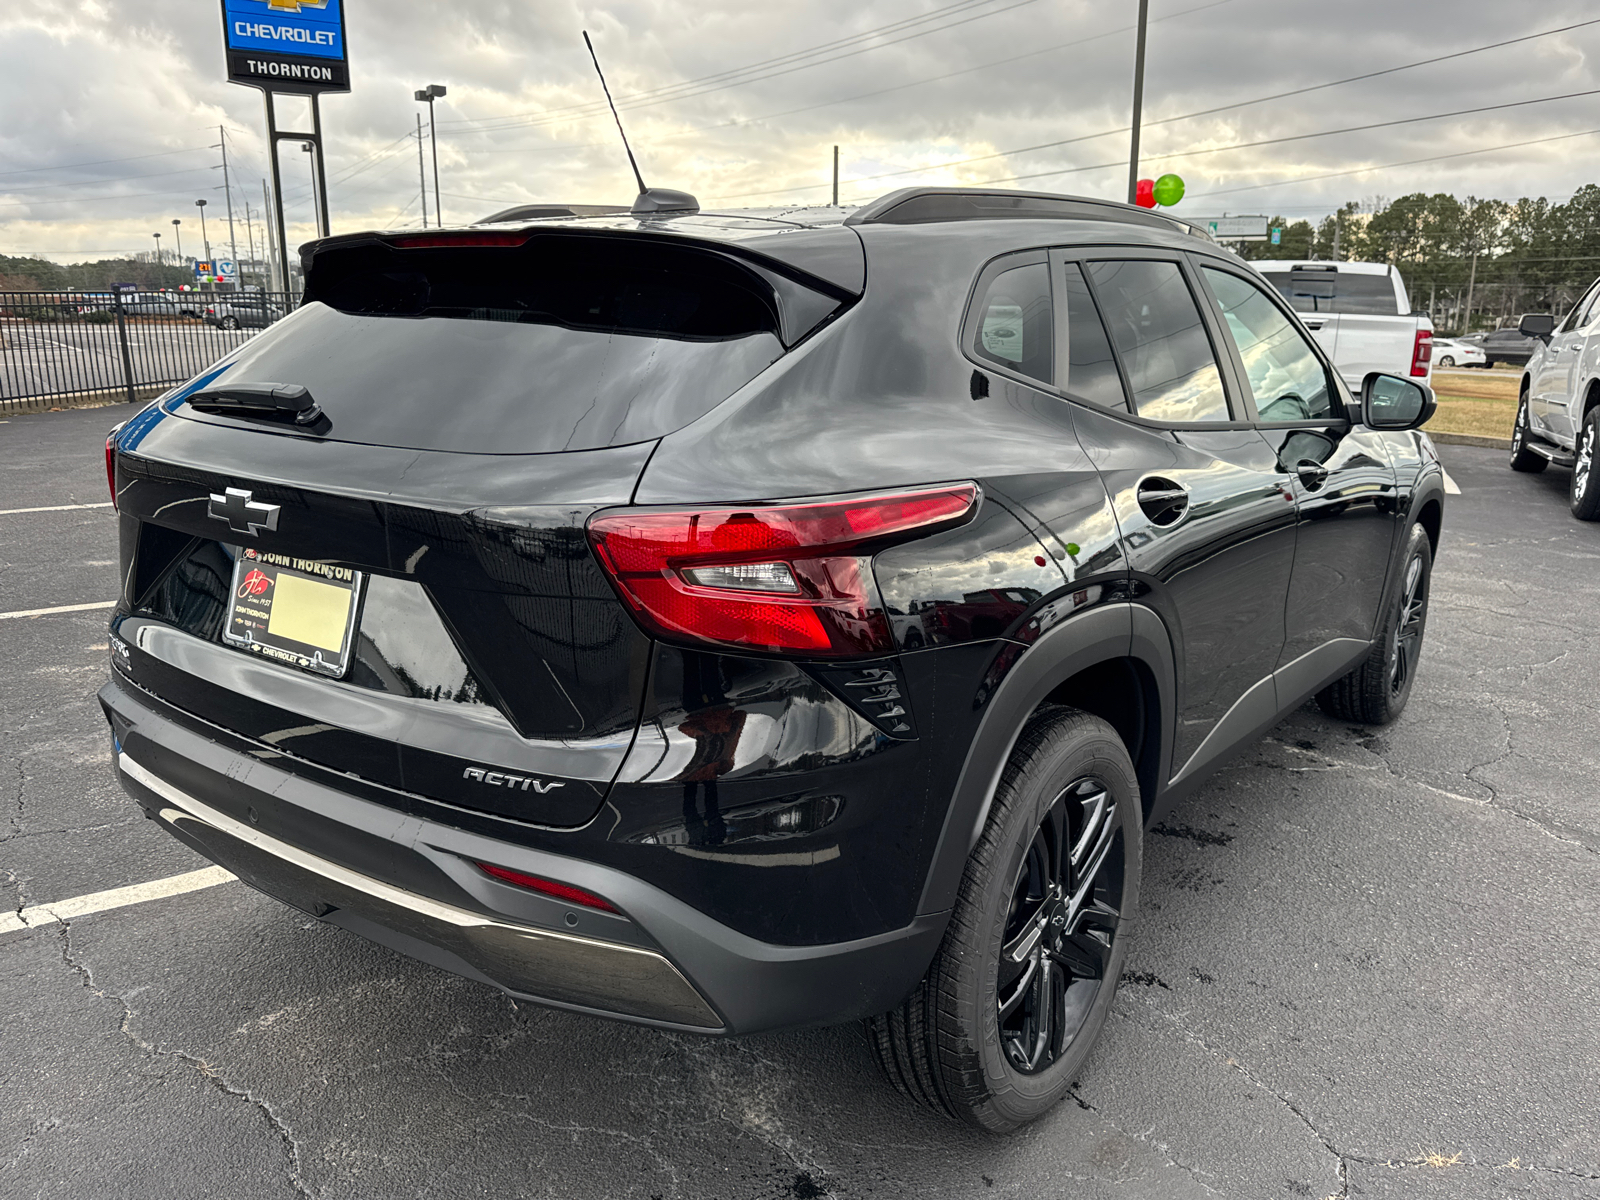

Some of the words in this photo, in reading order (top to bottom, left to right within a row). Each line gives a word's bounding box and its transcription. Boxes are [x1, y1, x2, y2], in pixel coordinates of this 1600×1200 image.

[235, 22, 336, 46] CHEVROLET
[247, 60, 332, 80] THORNTON
[262, 552, 290, 567] JOHN
[262, 647, 298, 663] CHEVROLET
[462, 766, 566, 794] ACTIV
